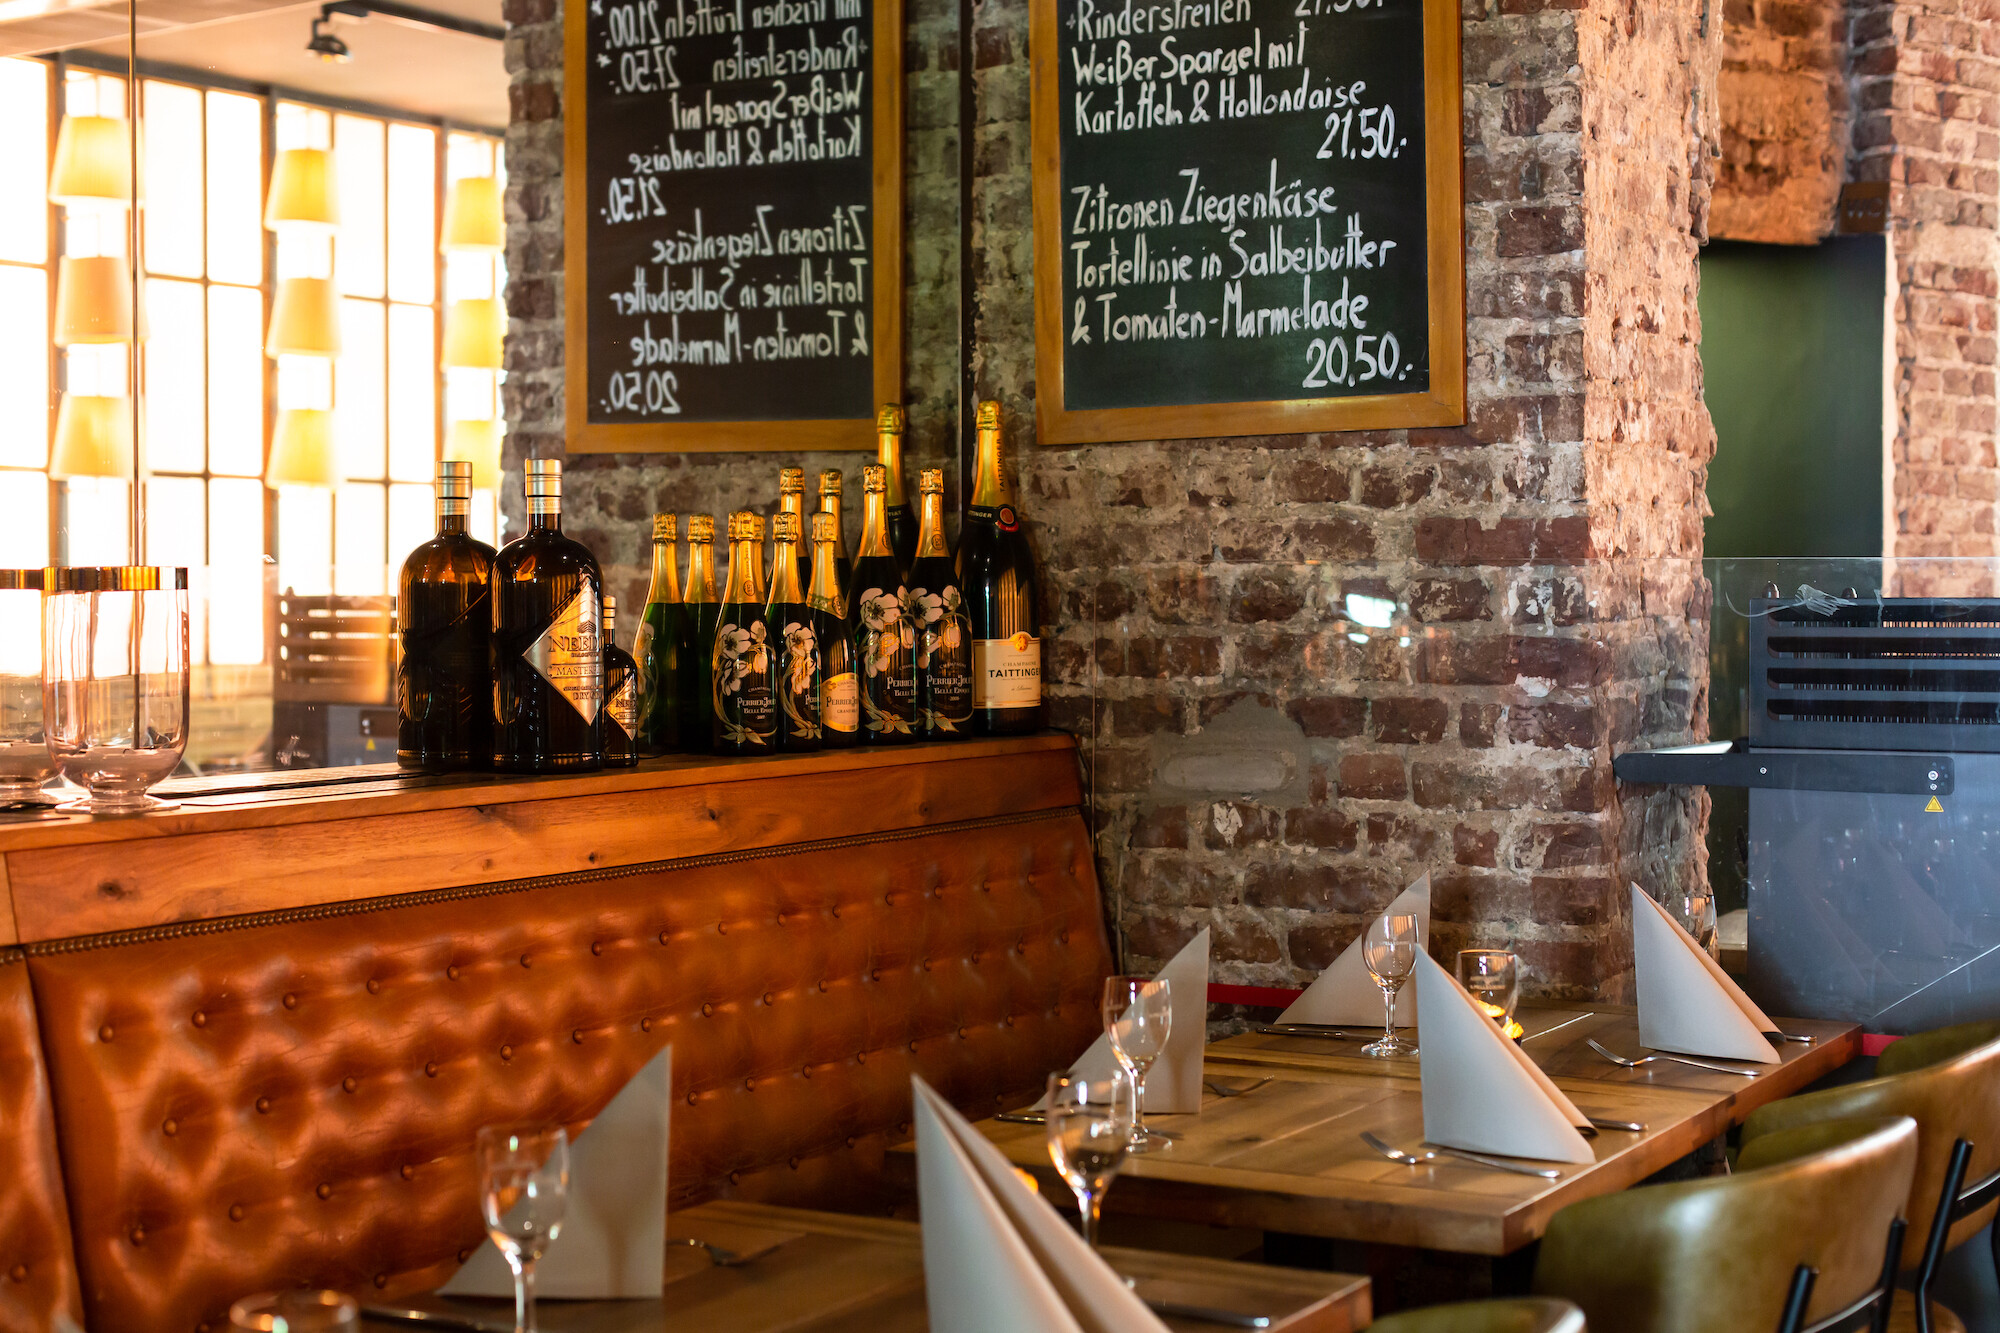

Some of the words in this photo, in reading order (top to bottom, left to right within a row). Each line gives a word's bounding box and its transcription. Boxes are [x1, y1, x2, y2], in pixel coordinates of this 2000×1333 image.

[1159, 29, 1260, 84] Spargel
[1268, 21, 1308, 69] mit
[1075, 81, 1183, 136] Kartoffeln
[1189, 79, 1211, 122] &
[1071, 183, 1173, 235] Zitronen
[1178, 158, 1338, 231] Ziegenkäse
[1070, 233, 1193, 289] Tortellinie
[1200, 247, 1222, 280] in
[1228, 212, 1397, 279] Salbeibutter
[1071, 295, 1092, 346] &
[1095, 274, 1369, 344] Tomaten-Marmelade
